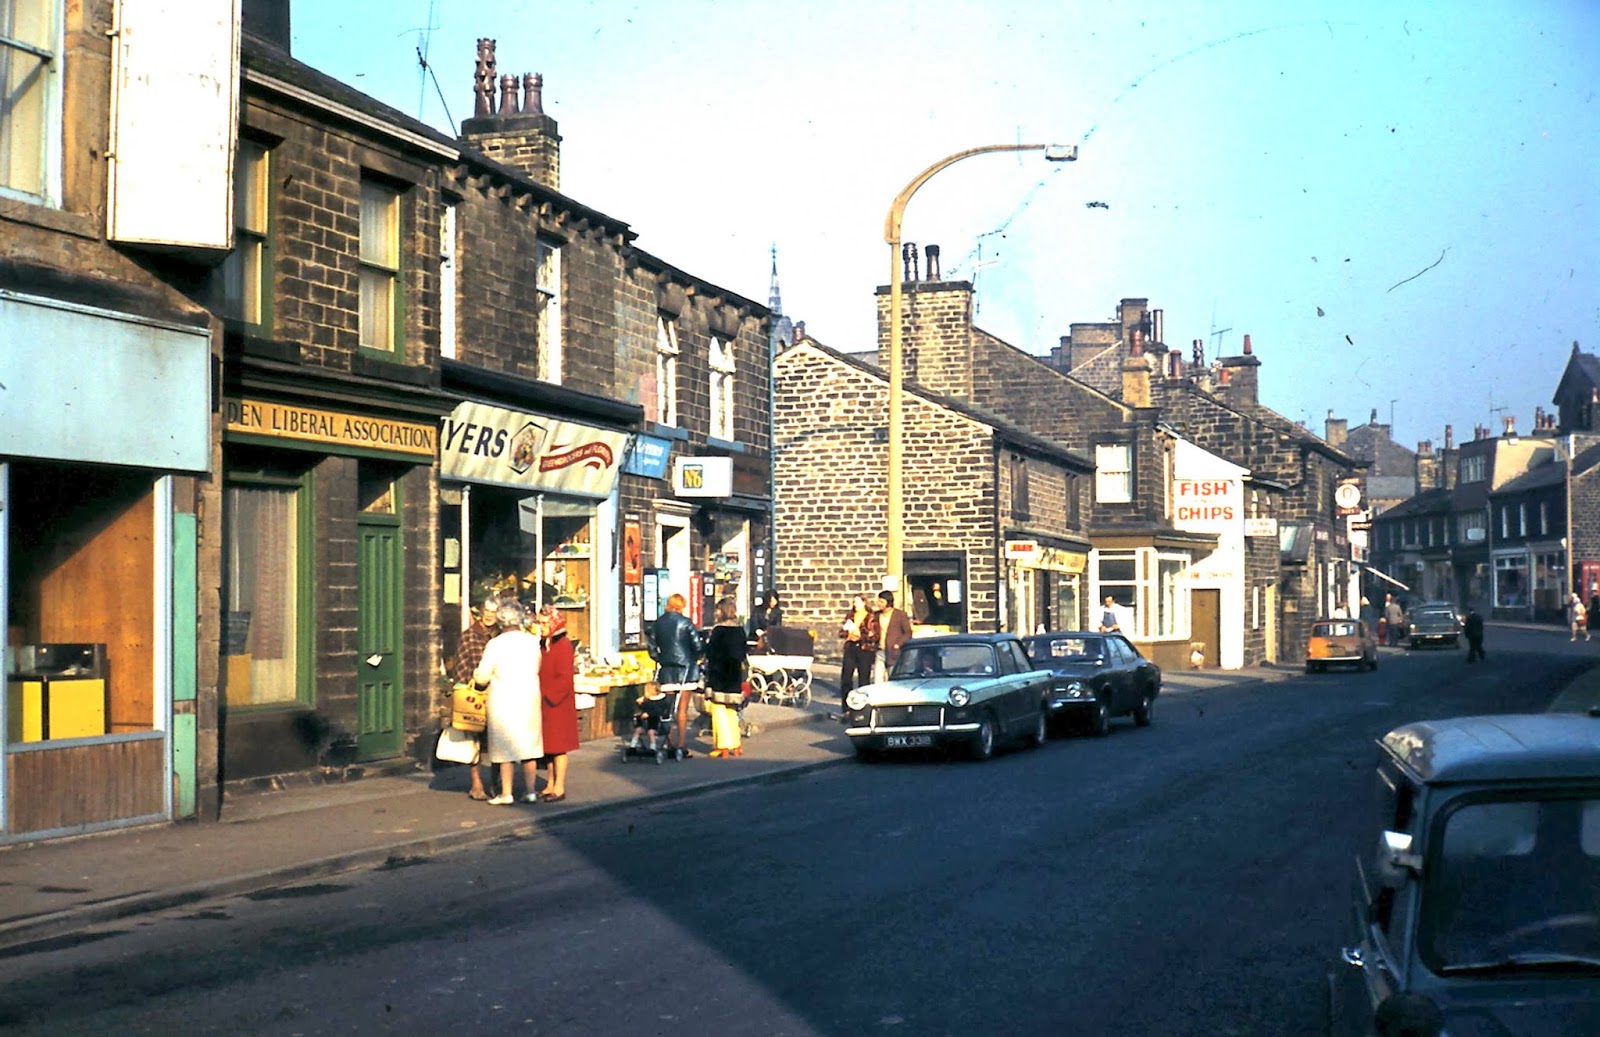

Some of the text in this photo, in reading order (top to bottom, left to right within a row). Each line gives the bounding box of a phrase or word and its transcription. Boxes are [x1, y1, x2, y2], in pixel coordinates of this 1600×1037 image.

[272, 407, 338, 438] LIBERAL
[342, 418, 433, 449] ASSOCIATION
[1180, 482, 1228, 496] FISH
[1178, 507, 1234, 520] CHIPS
